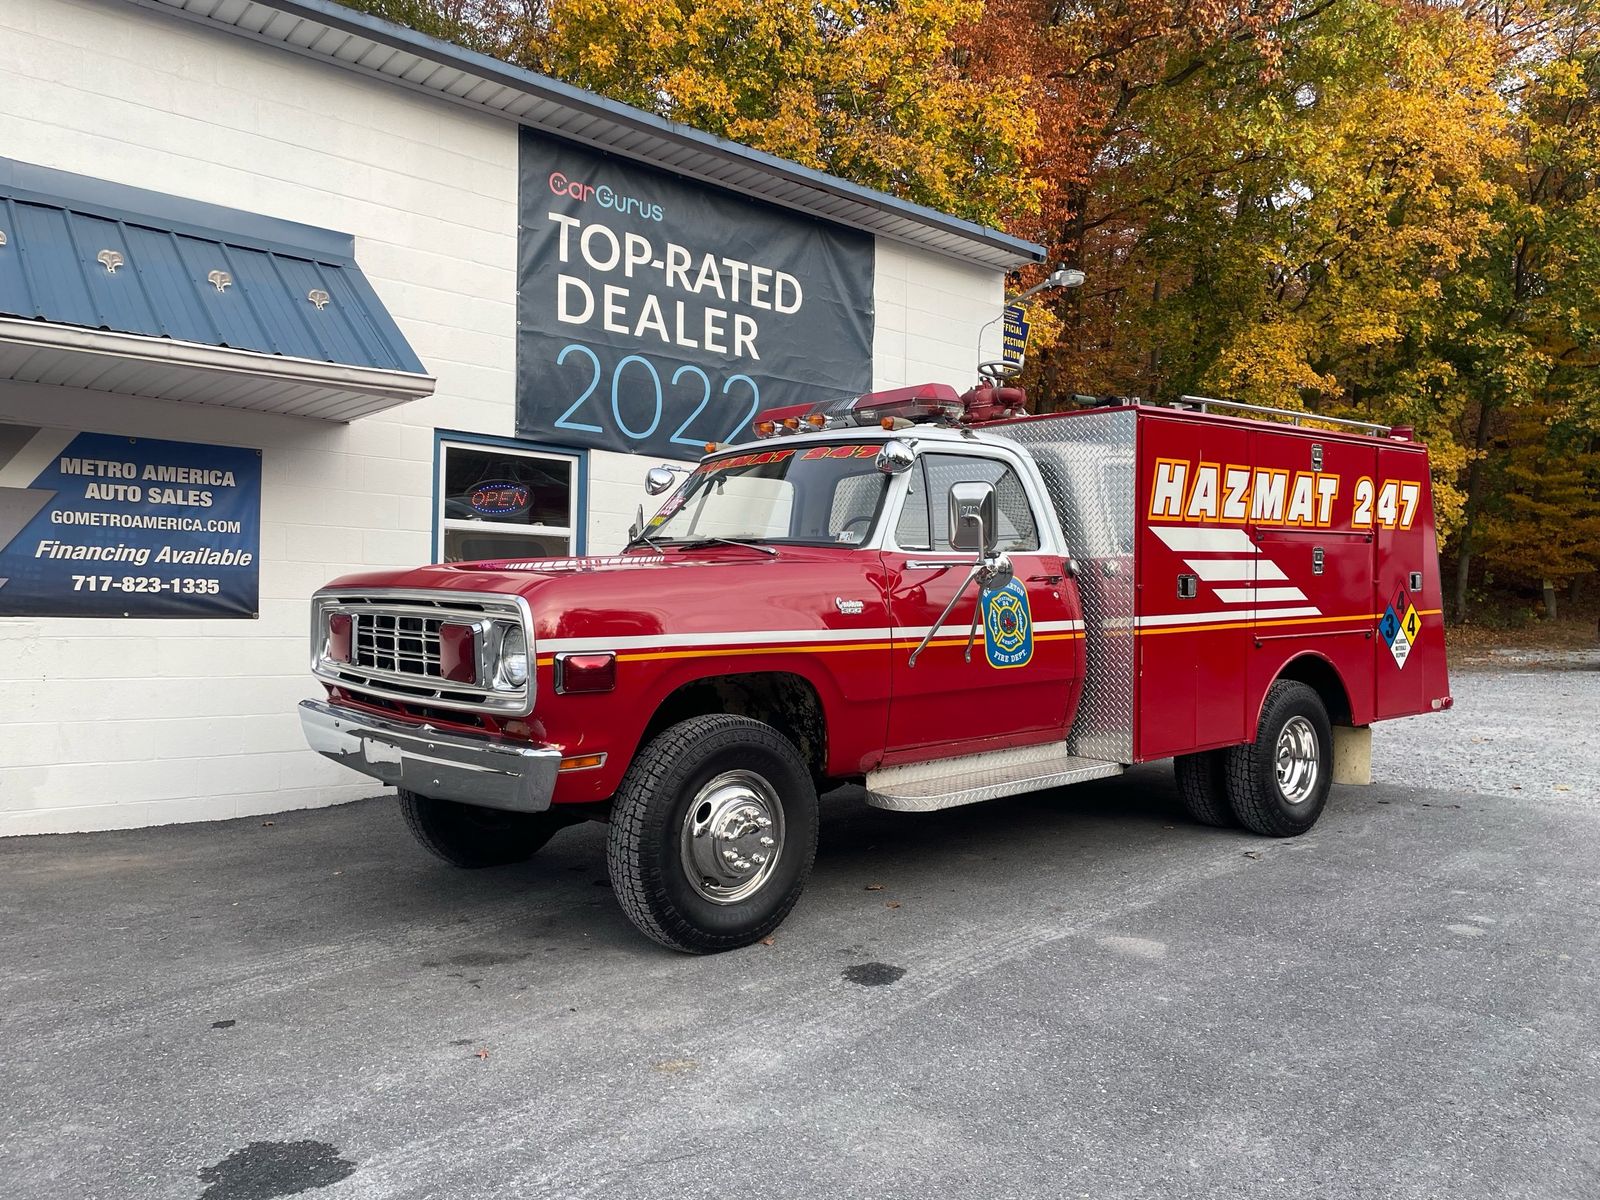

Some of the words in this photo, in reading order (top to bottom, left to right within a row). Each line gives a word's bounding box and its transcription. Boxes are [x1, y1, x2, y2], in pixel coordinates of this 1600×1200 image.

[549, 172, 664, 222] CarGurus
[548, 211, 803, 315] TOP-RATED
[557, 273, 760, 360] DEALER
[1003, 336, 1024, 348] PECTION
[554, 343, 760, 447] 2022
[60, 457, 136, 479] METRO
[142, 464, 236, 487] AMERICA
[85, 483, 141, 502] AUTO
[148, 487, 213, 507] SALES
[472, 491, 528, 506] OPEN
[1148, 457, 1340, 527] HAZMAT
[1351, 476, 1421, 530] 247
[51, 510, 241, 534] GOMETROAMERICA.COM
[35, 540, 151, 566] Financing
[155, 546, 252, 567] Available
[72, 575, 219, 594] 717-823-1335
[1397, 591, 1405, 614] 4
[1386, 614, 1394, 638] 3
[1407, 613, 1415, 636] 4
[993, 651, 1009, 663] FIRE
